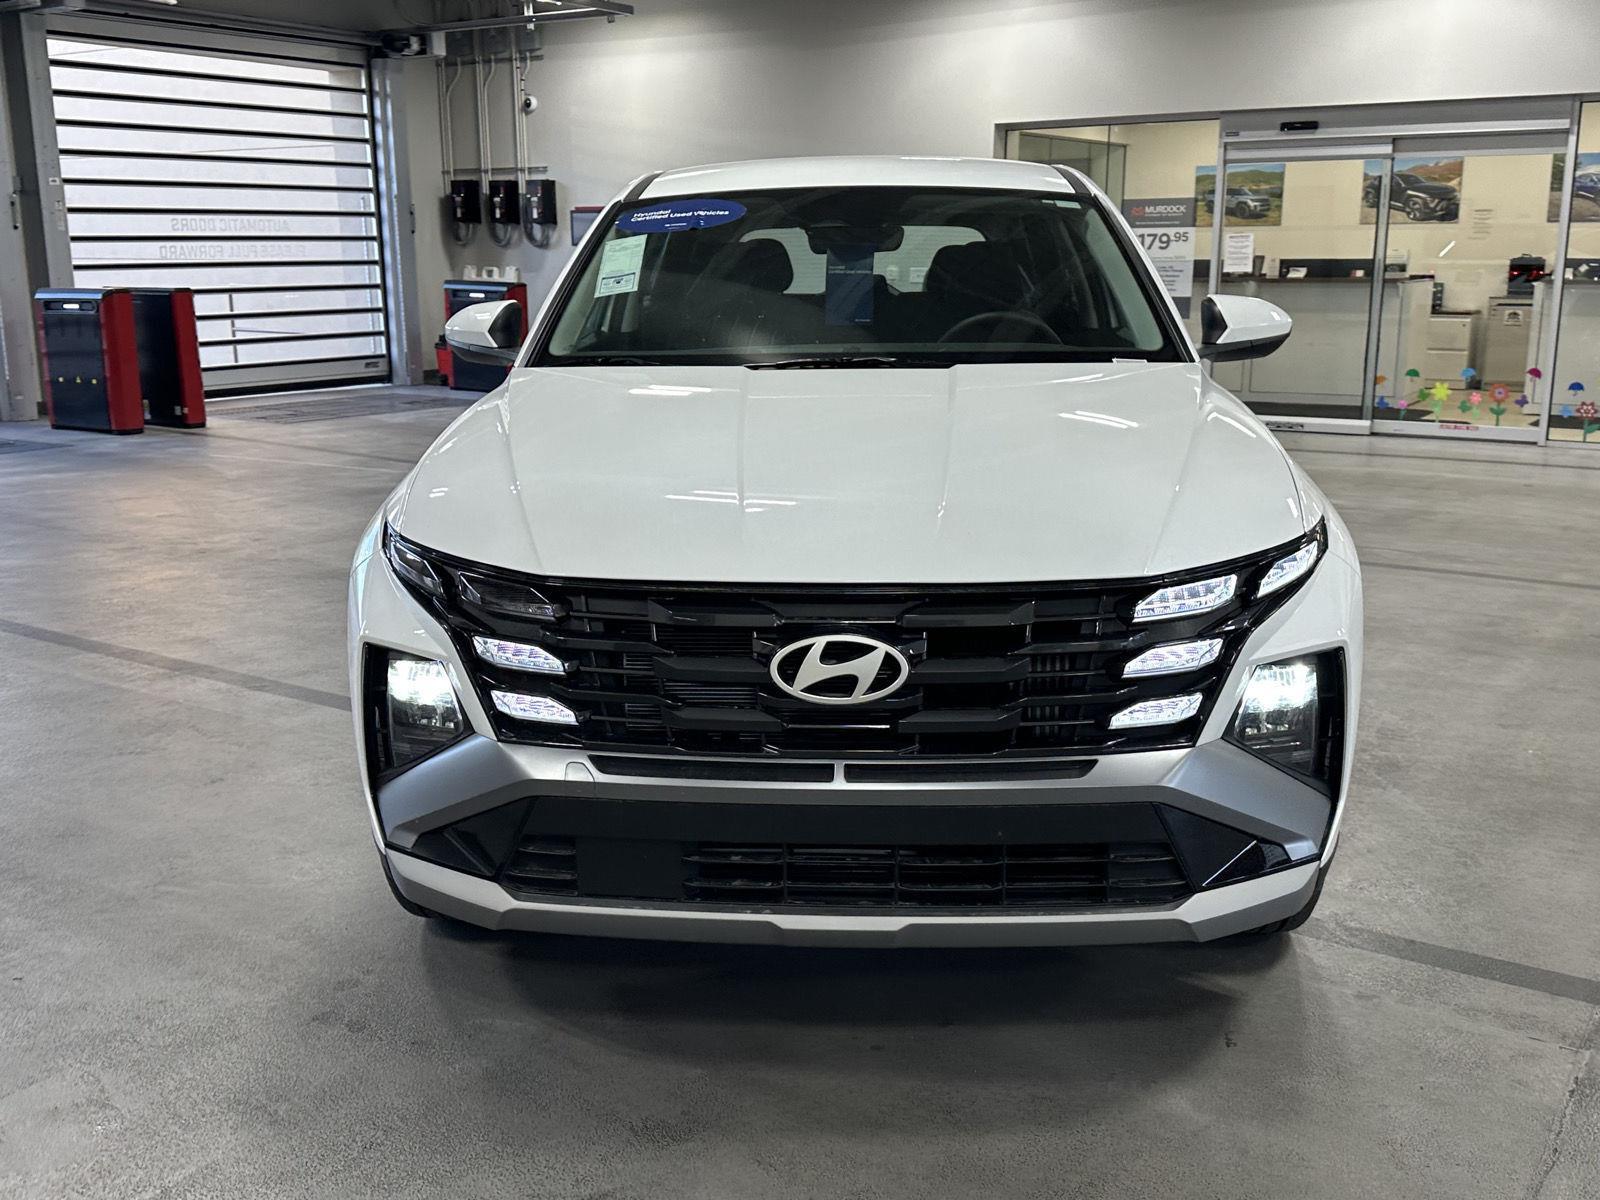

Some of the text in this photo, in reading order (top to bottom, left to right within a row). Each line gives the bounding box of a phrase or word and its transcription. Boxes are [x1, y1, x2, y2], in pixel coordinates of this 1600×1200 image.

[633, 209, 672, 218] Hyundai
[1145, 205, 1186, 213] MURDOCK
[630, 213, 669, 222] Certified
[694, 209, 730, 217] Vehicles
